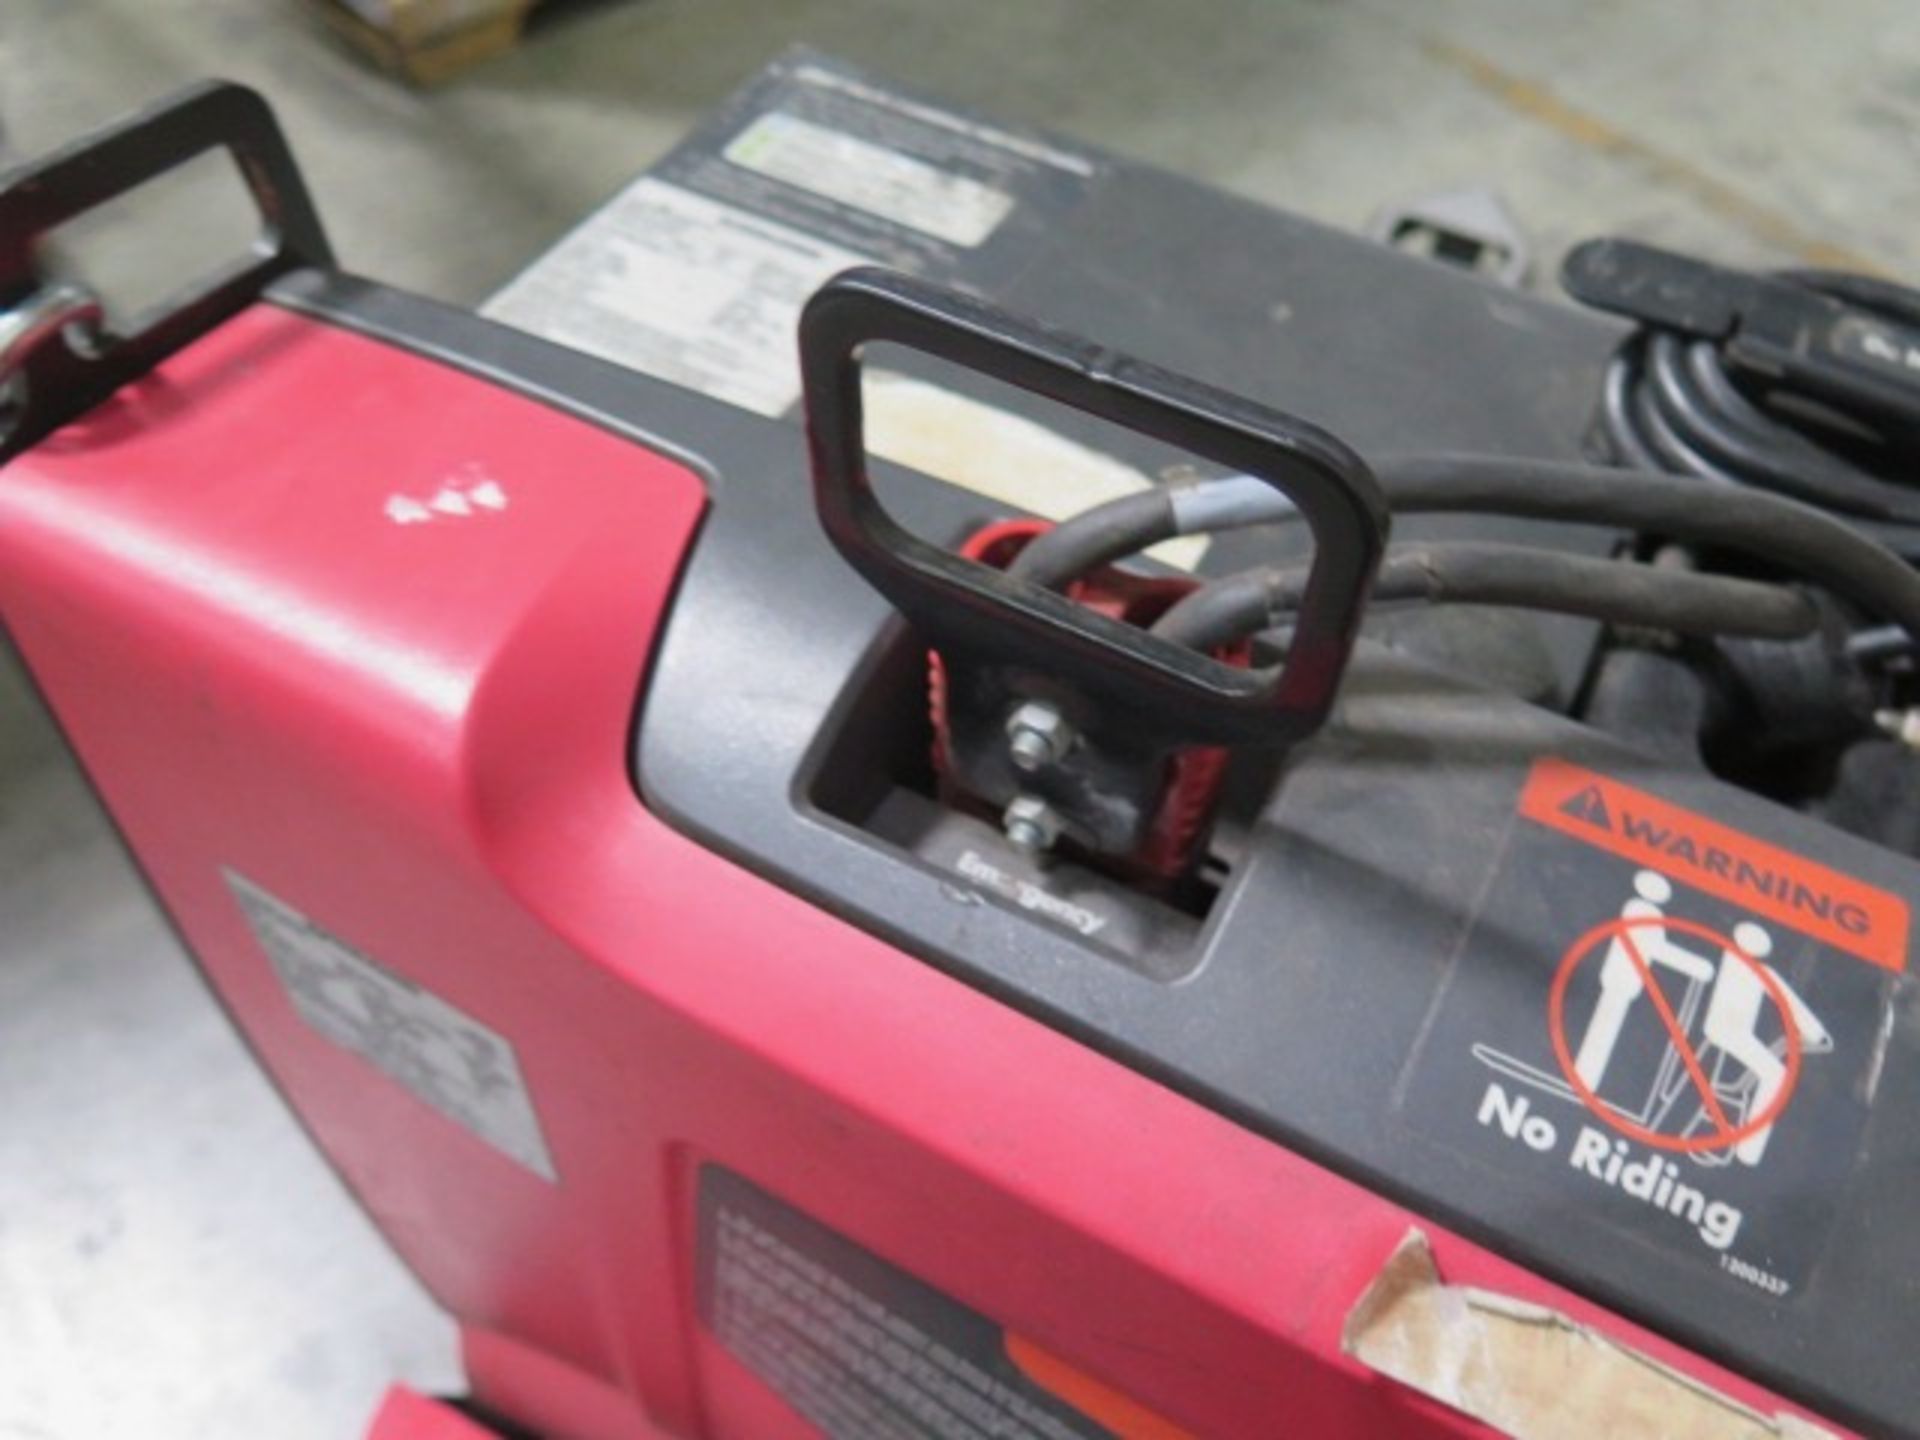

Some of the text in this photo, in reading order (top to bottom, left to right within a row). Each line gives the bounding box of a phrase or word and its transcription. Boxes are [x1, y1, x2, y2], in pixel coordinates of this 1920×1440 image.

[957, 851, 1106, 935] Emgency
[1622, 810, 1871, 936] WARNING
[1477, 1083, 1742, 1249] No Riding
